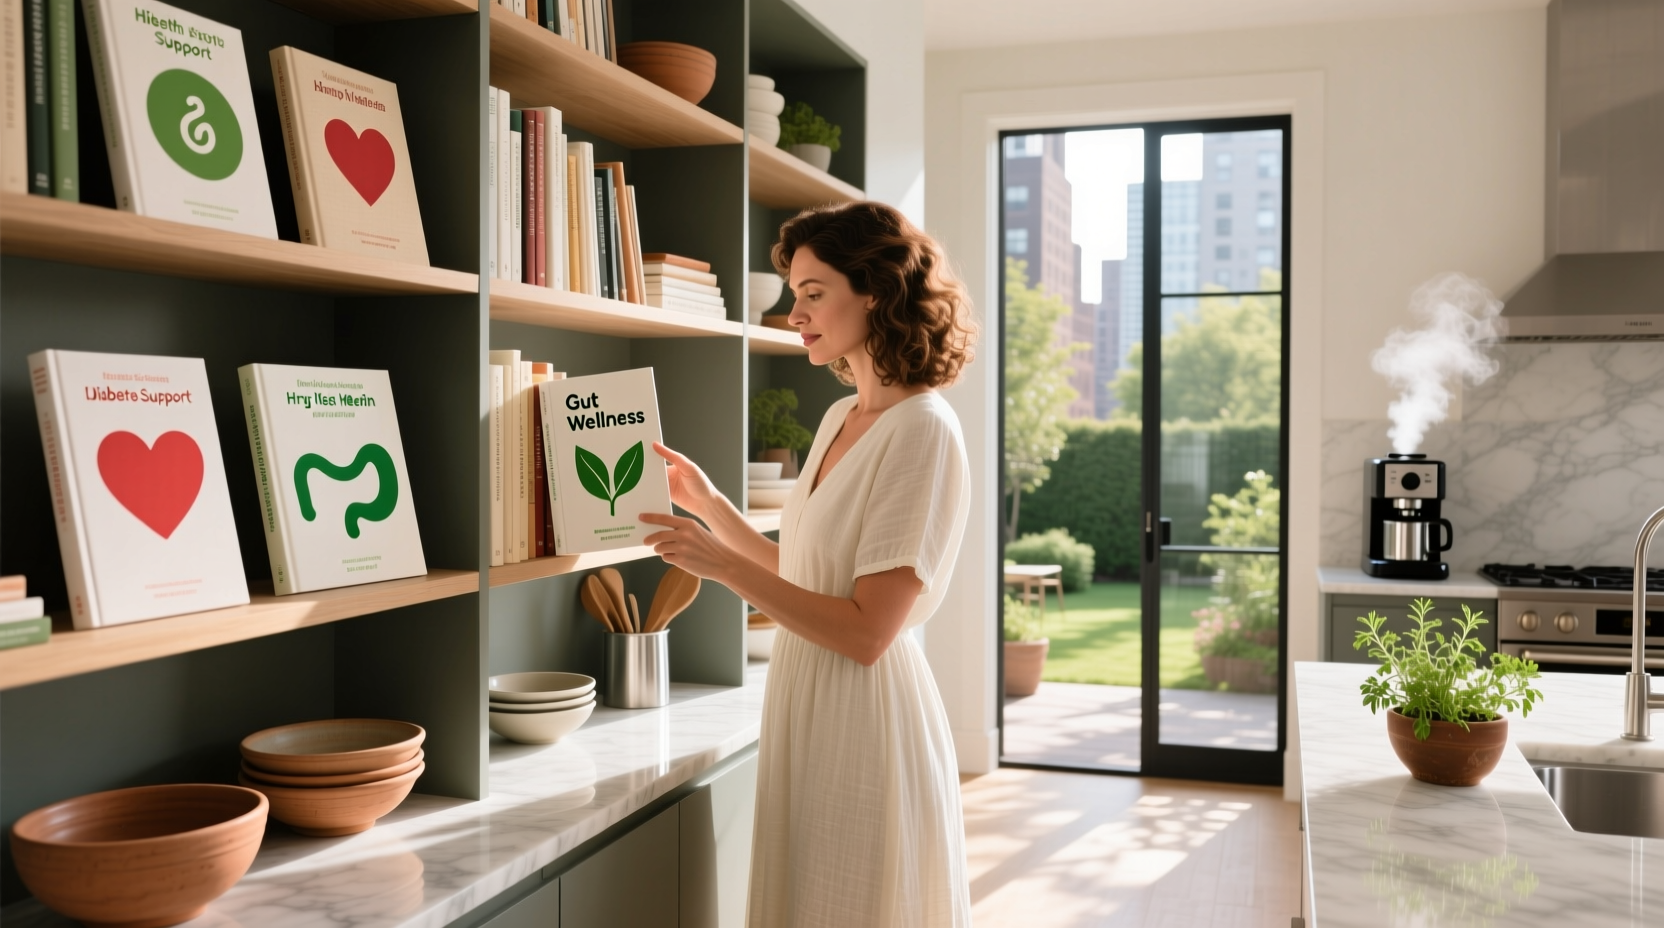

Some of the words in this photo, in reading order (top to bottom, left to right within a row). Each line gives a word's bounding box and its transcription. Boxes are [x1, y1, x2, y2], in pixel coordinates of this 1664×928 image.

[154, 31, 212, 60] Support
[140, 388, 192, 406] Support
[565, 392, 599, 411] Gut
[566, 411, 645, 431] Wellness
